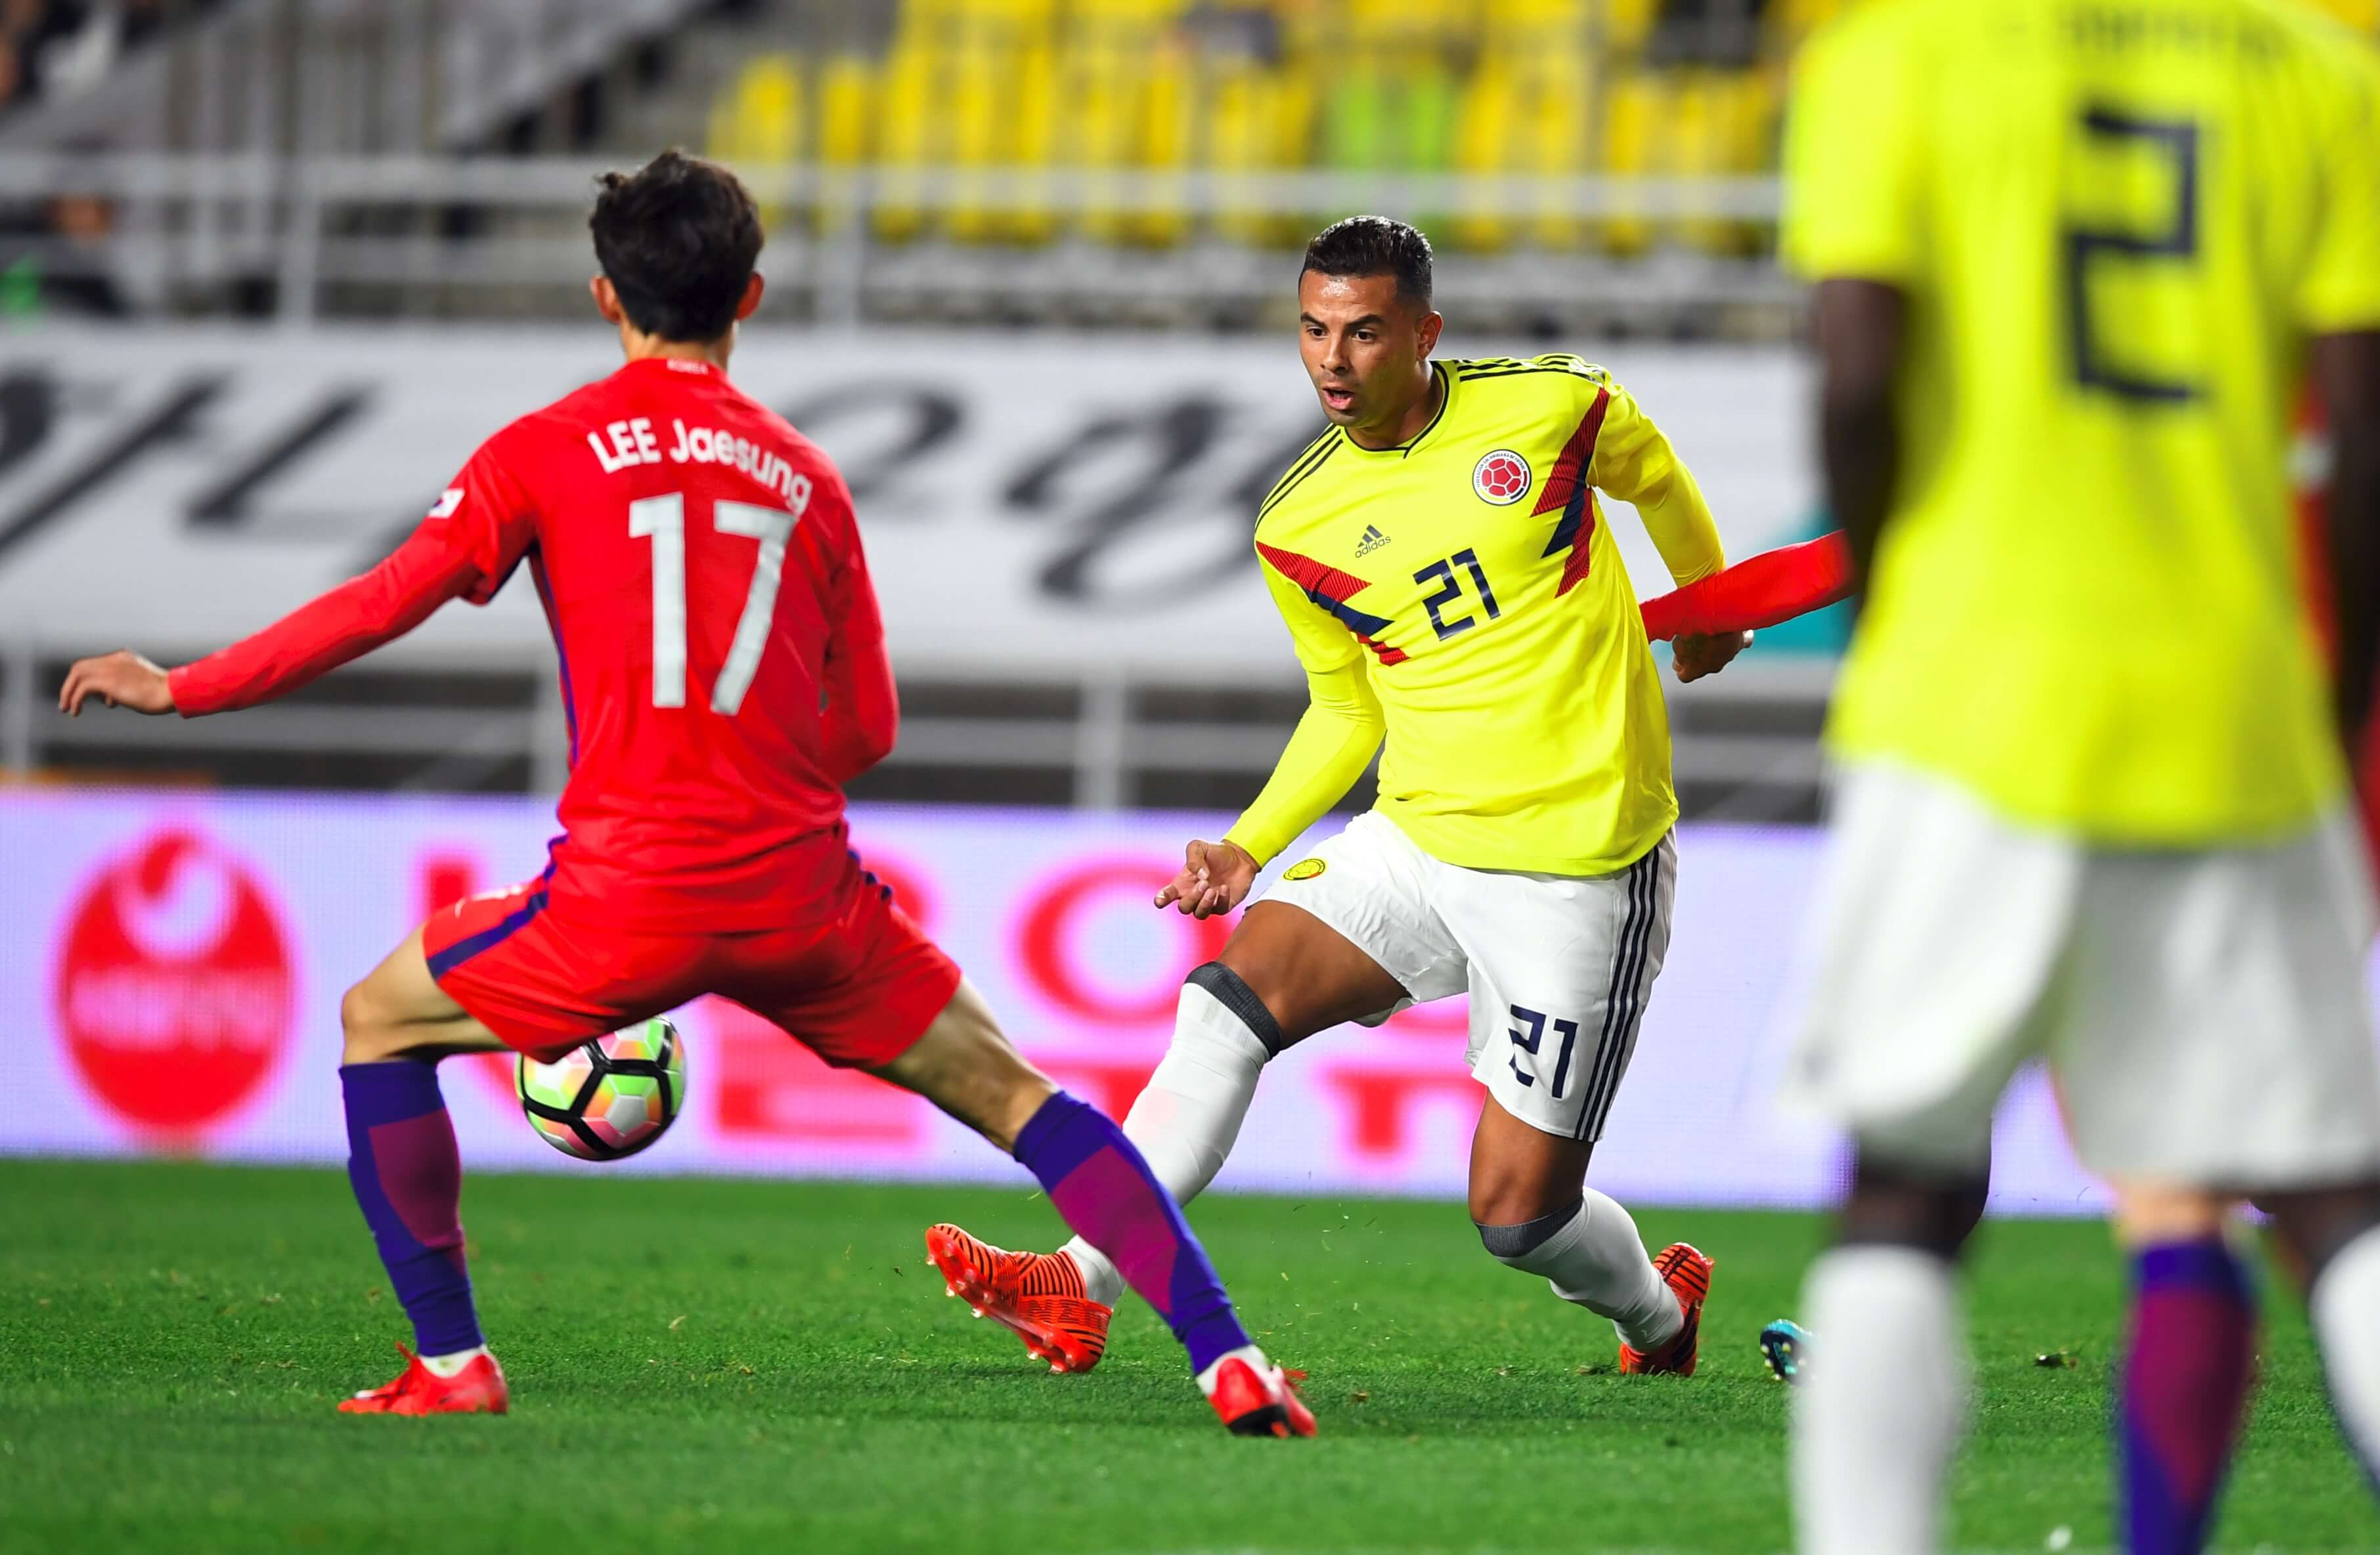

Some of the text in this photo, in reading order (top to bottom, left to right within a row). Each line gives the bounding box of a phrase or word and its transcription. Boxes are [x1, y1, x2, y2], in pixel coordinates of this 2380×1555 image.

[2064, 104, 2199, 406] 2
[587, 417, 814, 519] LEE Jaesung
[1355, 536, 1392, 558] adidas
[1413, 548, 1501, 642] 21
[628, 491, 797, 716] 17
[1507, 1004, 1579, 1099] 21
